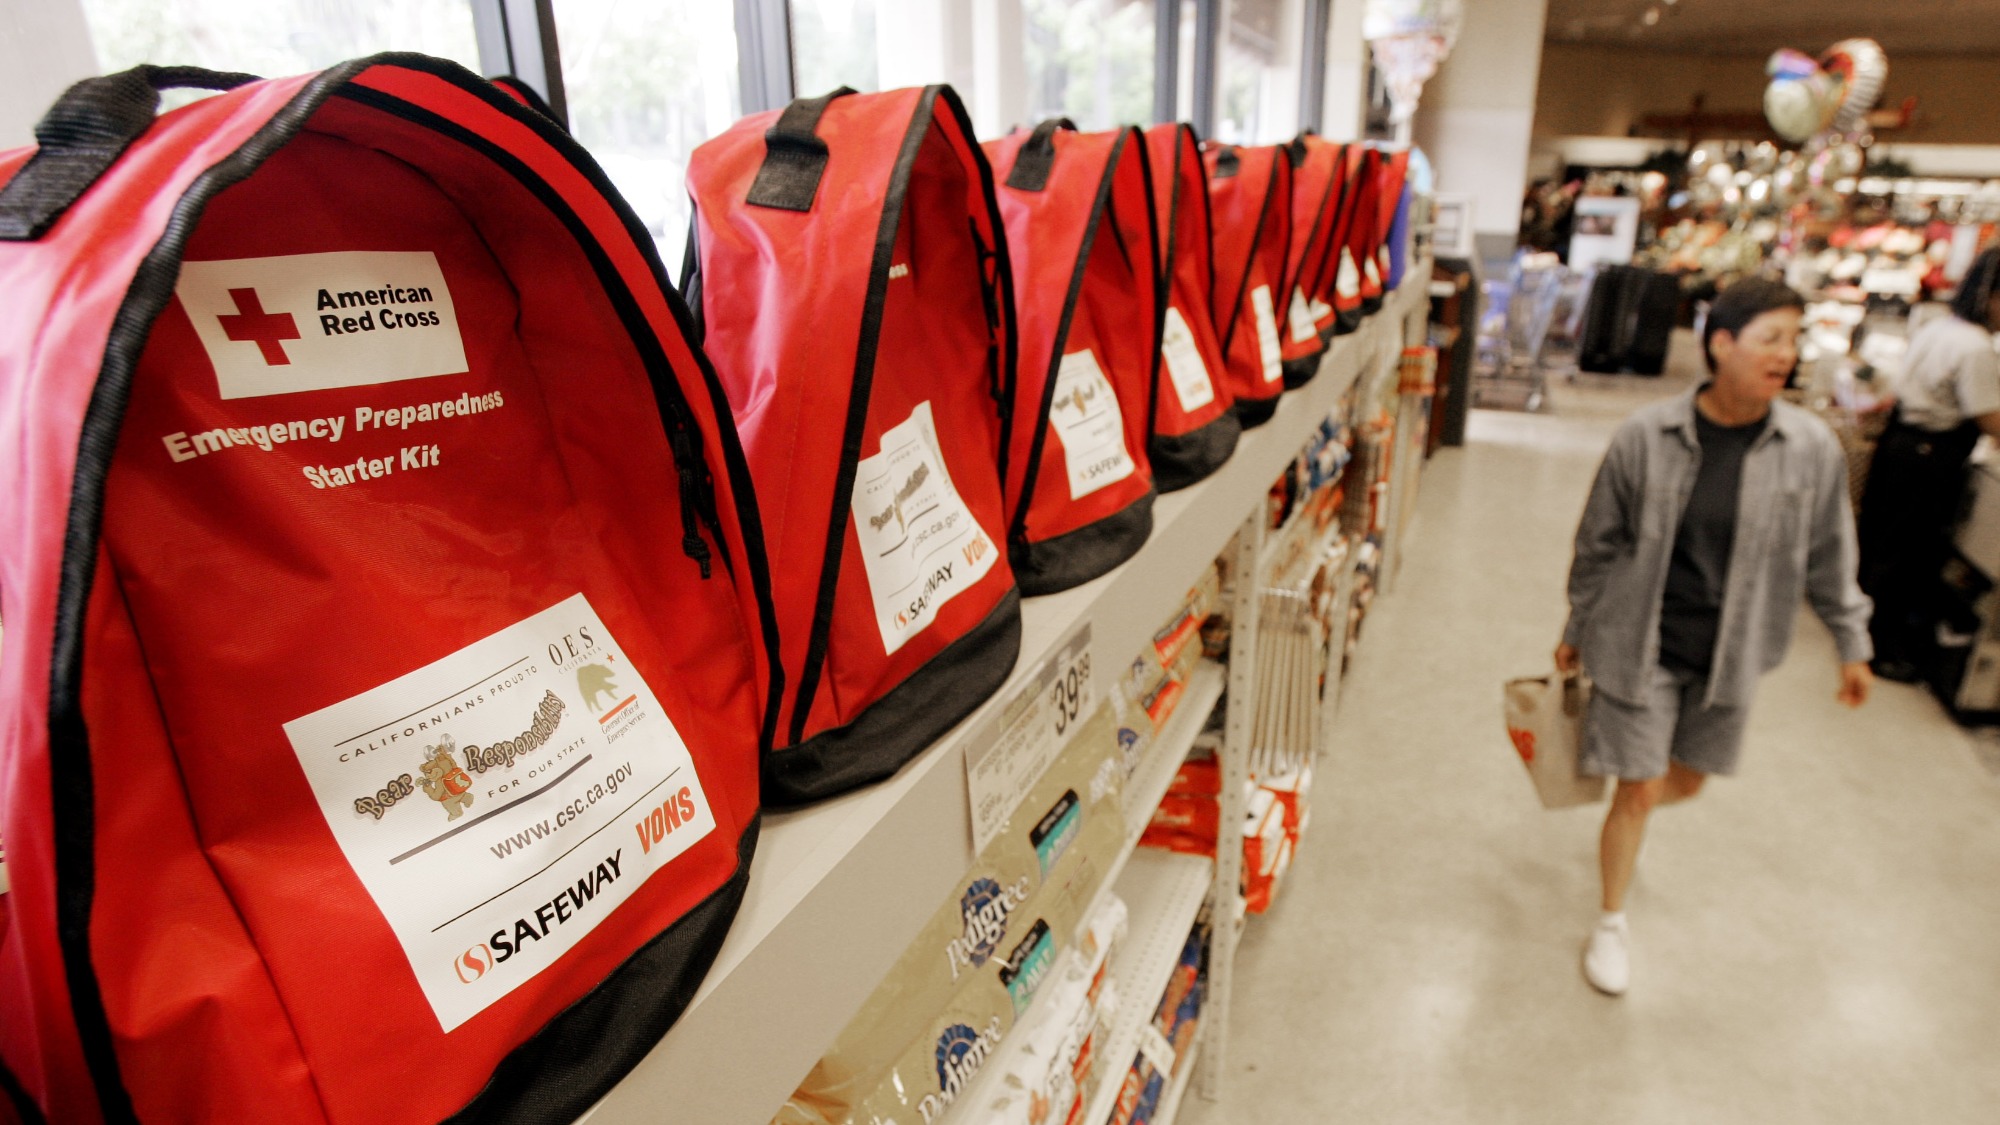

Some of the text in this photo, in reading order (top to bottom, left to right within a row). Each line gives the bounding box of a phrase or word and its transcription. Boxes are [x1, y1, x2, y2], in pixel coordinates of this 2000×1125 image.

[317, 284, 433, 311] American
[320, 307, 440, 336] Red Cross
[162, 390, 504, 463] Emergency Preparedness
[302, 444, 440, 489] Starter Kit
[548, 625, 594, 666] OES
[558, 646, 602, 675] CALIFORNIA
[339, 665, 538, 763] CALIFORNIANS PROUD TO
[354, 688, 567, 819] Bear Responsibility
[488, 736, 587, 799] FOR OUR STATE
[489, 762, 634, 860] www.csc.ca.gov
[489, 786, 696, 964] SAFEWAY VONS
[945, 875, 1029, 980] Pedigree
